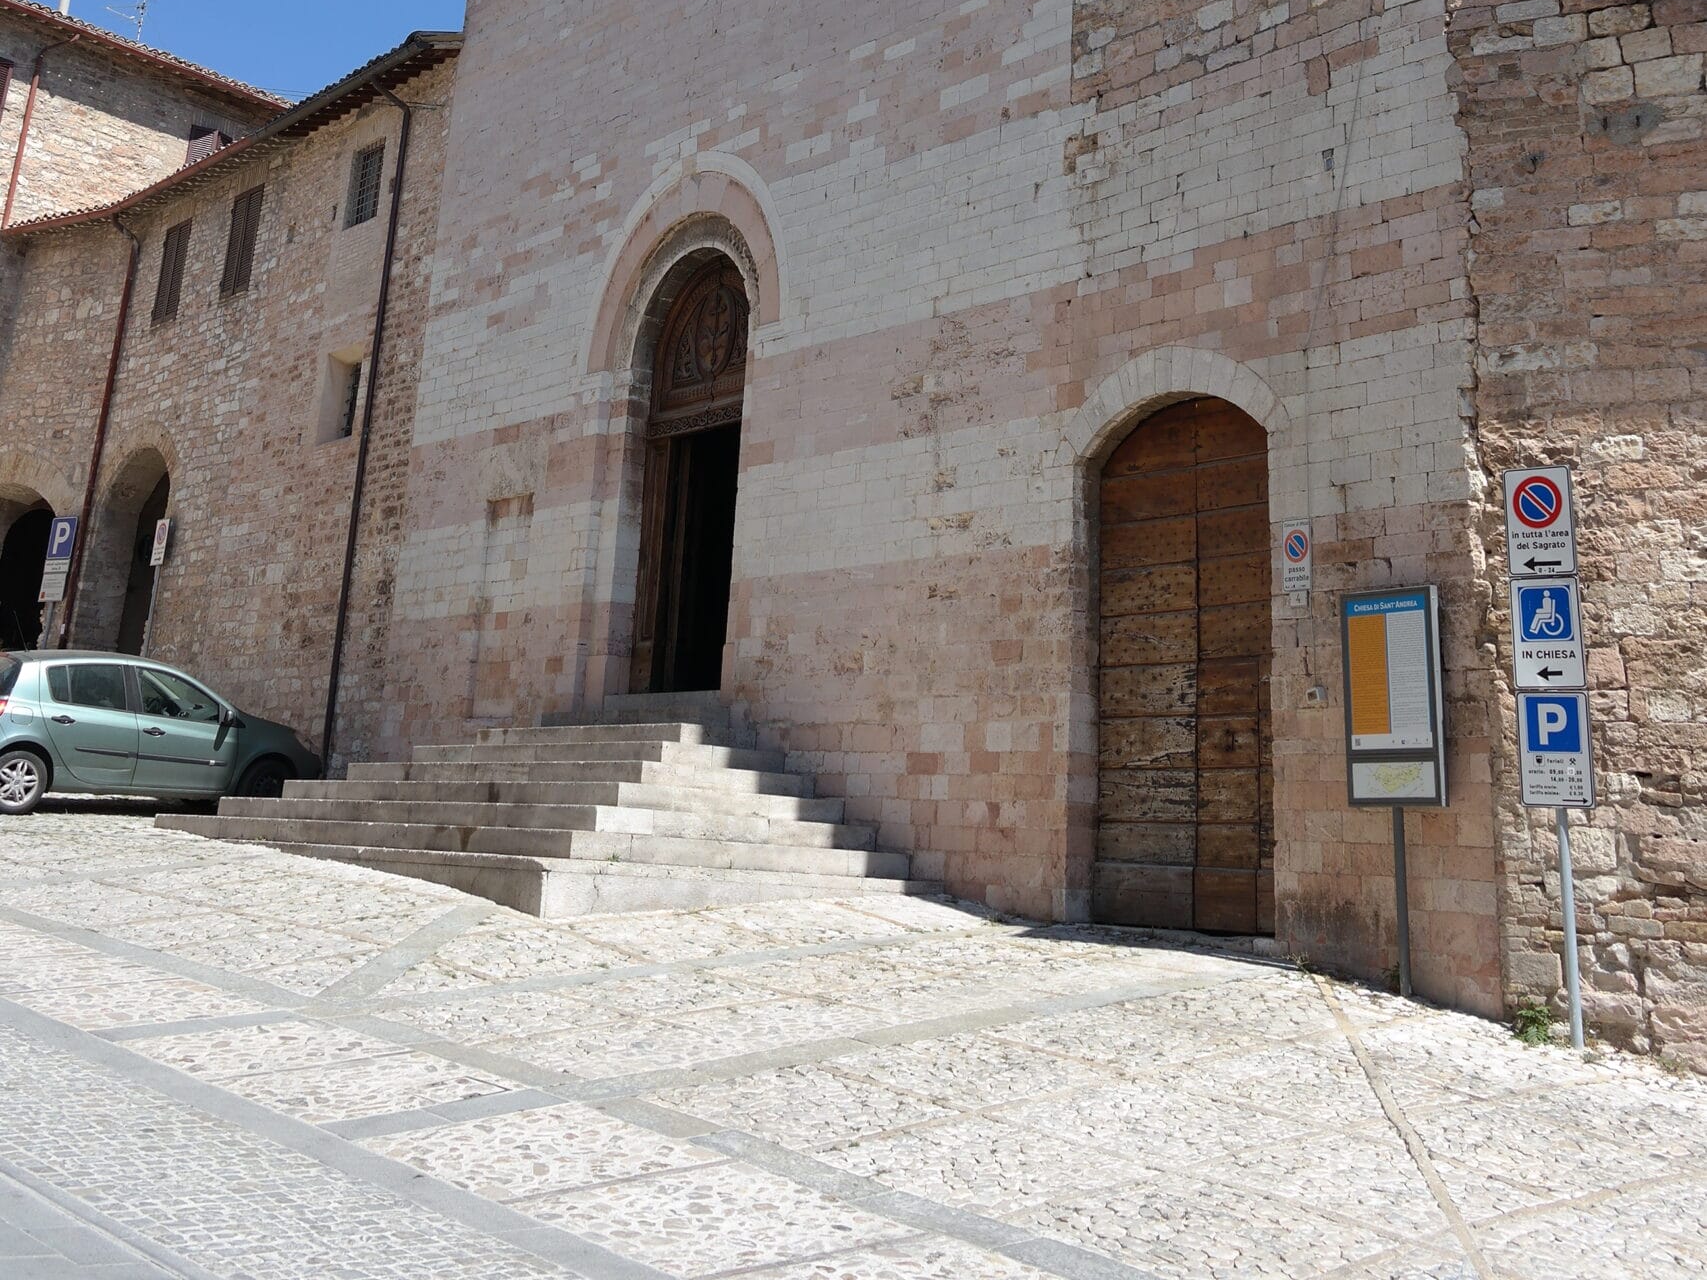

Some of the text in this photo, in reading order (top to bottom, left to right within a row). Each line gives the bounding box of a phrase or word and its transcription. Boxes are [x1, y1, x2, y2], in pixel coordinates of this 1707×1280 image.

[52, 522, 70, 554] P
[1516, 541, 1566, 550] del Sagrato
[1288, 566, 1305, 574] passo
[1353, 604, 1373, 612] CHIESA
[1522, 650, 1576, 659] IN CHIESA
[1537, 703, 1567, 745] P
